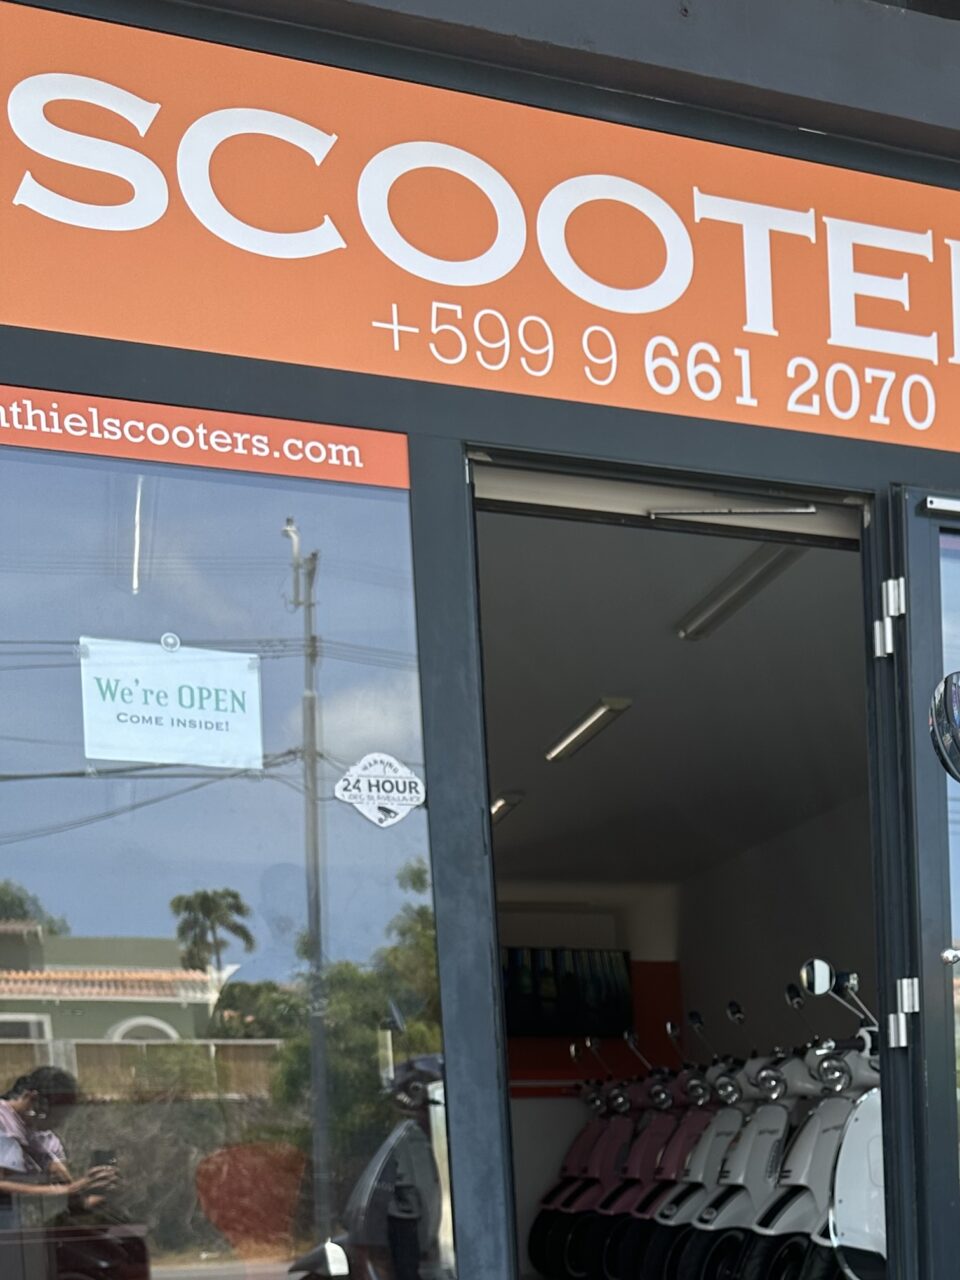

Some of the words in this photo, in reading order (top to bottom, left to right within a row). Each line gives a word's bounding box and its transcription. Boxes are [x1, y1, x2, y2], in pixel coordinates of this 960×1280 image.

[371, 300, 555, 377] +599
[581, 324, 618, 386] 9
[643, 335, 758, 407] 661
[786, 355, 936, 431] 2070
[95, 676, 169, 707] We're
[177, 684, 248, 715] OPEN
[116, 711, 164, 728] COME
[170, 717, 231, 733] INSIDE!
[342, 778, 362, 793] 24
[367, 778, 421, 796] HOUR
